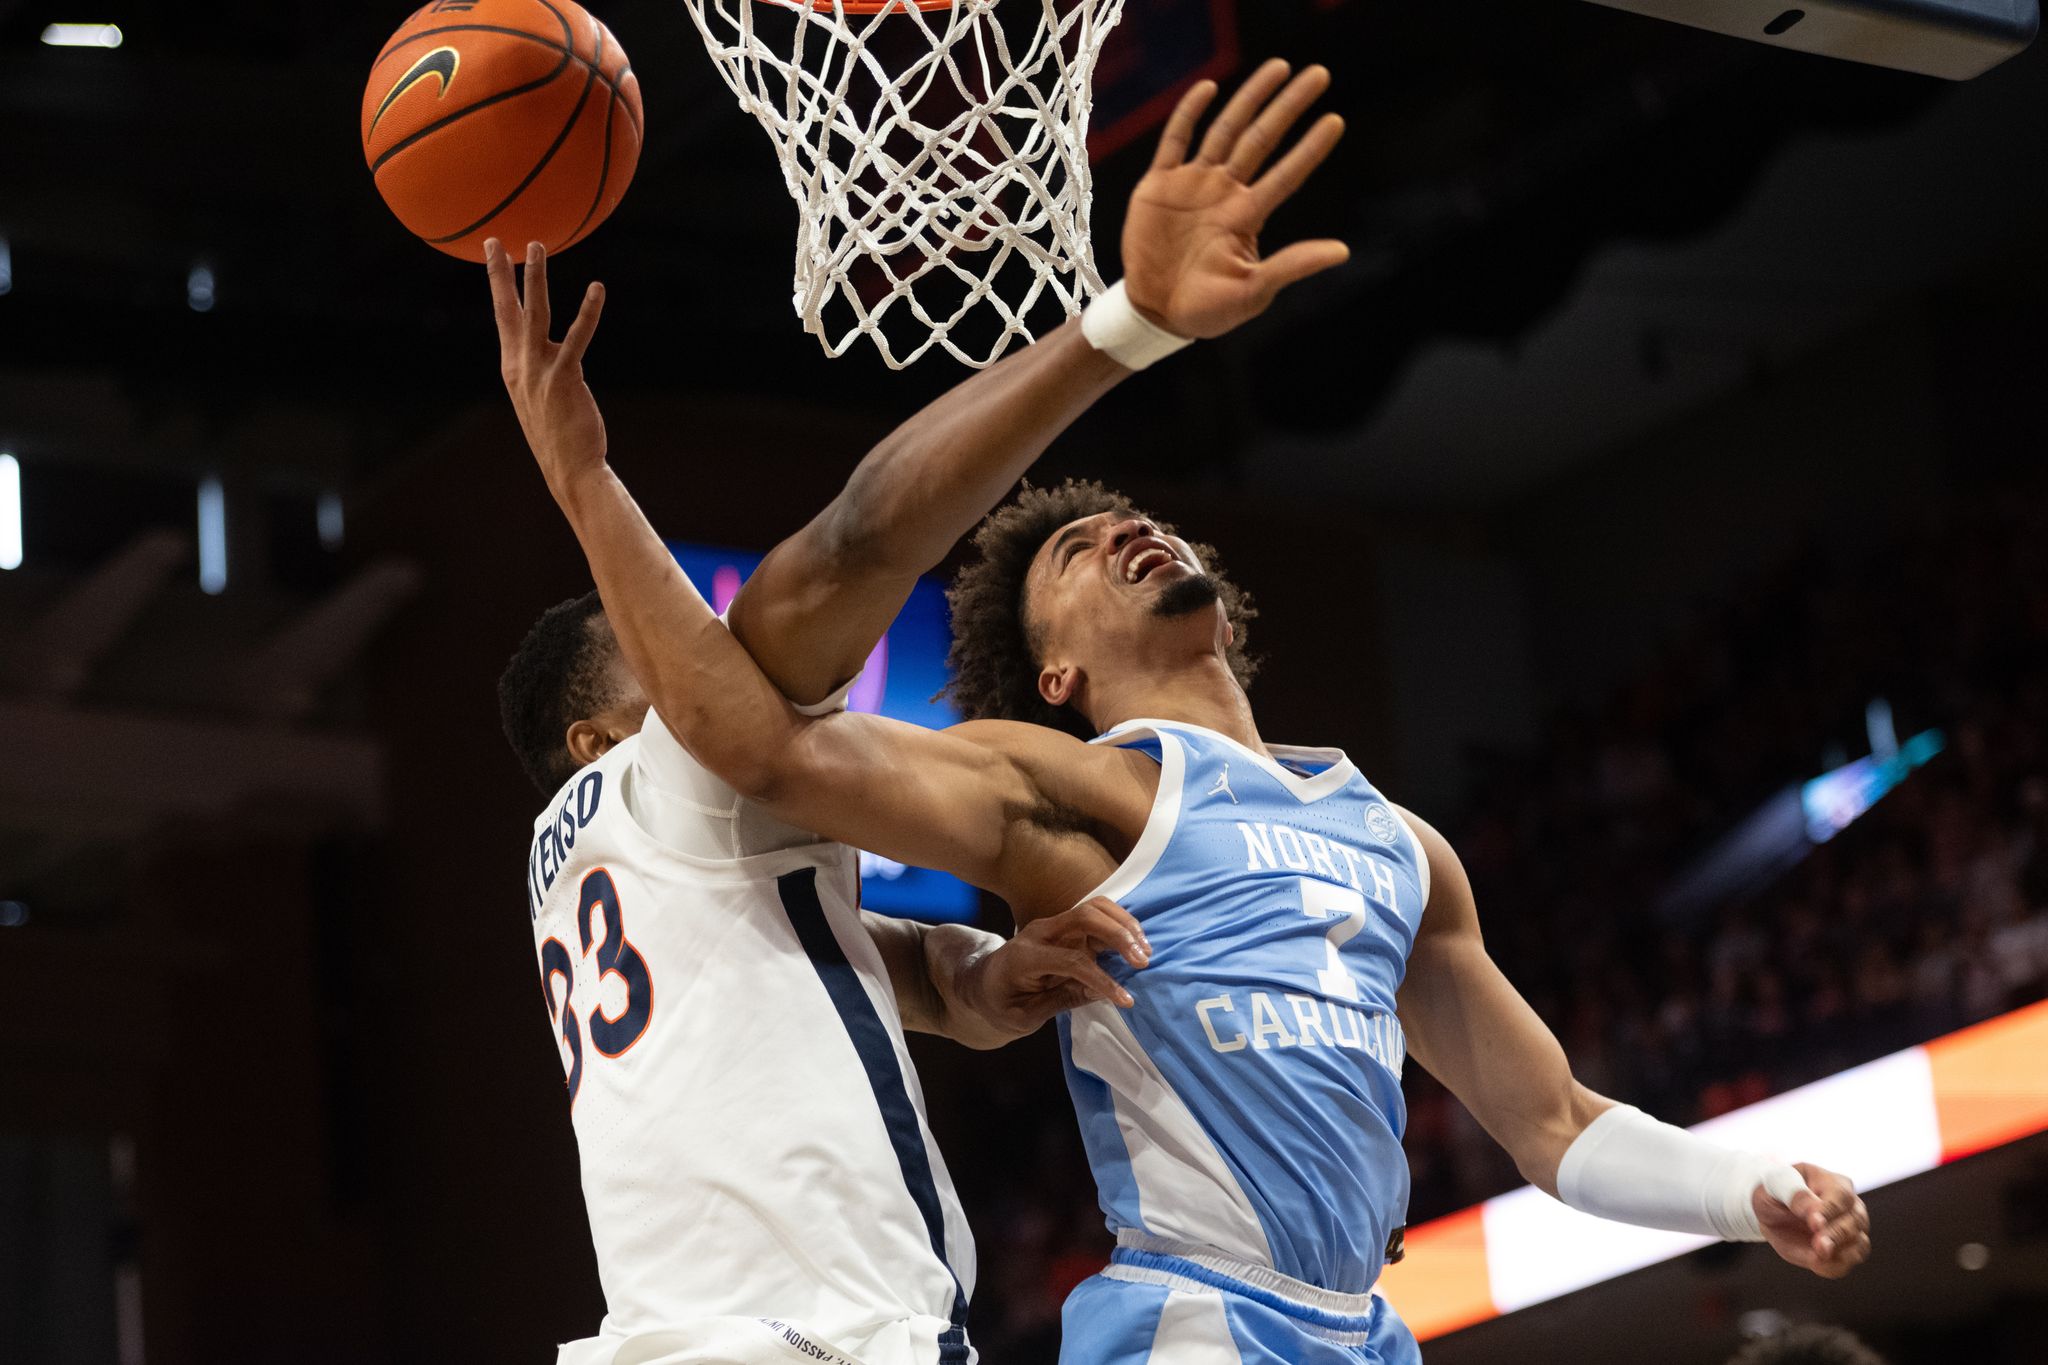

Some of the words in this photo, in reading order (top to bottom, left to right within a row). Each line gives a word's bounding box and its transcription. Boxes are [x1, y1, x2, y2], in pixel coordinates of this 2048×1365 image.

[1236, 822, 1401, 918] NORTH
[541, 866, 654, 1118] 33
[1299, 876, 1366, 1002] 7
